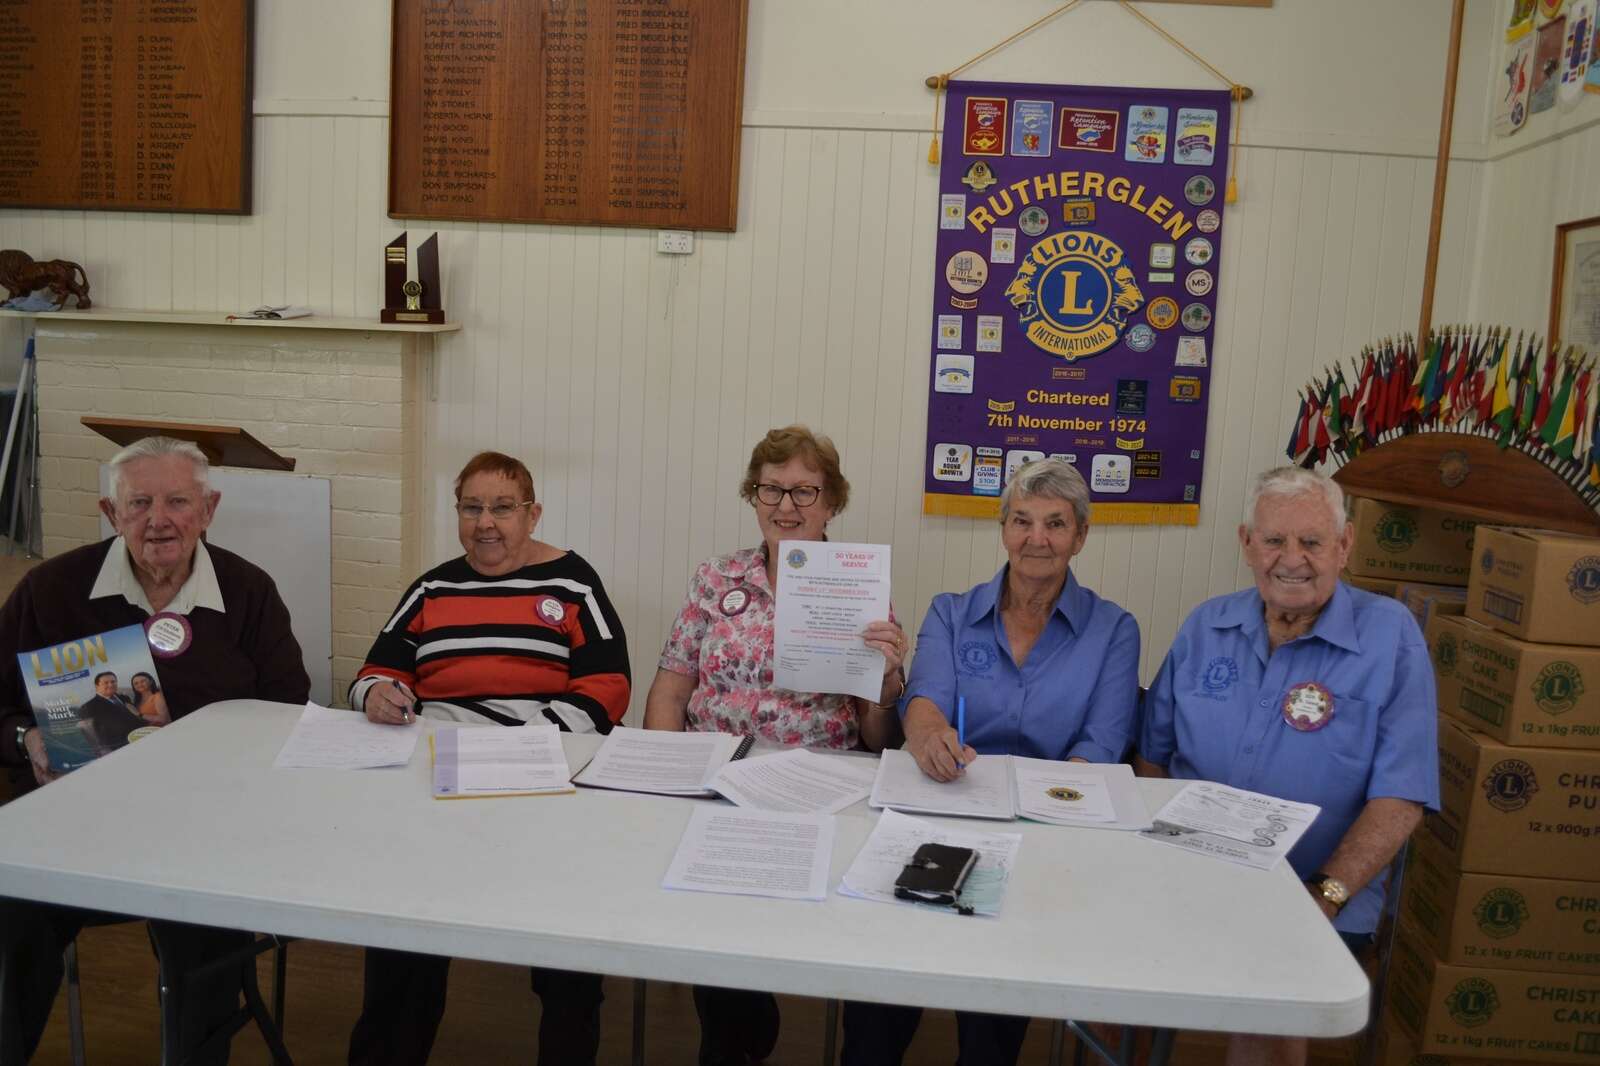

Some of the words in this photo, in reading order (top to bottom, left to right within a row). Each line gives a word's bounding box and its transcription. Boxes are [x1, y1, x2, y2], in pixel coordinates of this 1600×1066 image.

[967, 171, 1193, 241] RUTHERGLEN
[1037, 234, 1118, 263] LIONS
[1191, 279, 1207, 287] MS
[1058, 271, 1093, 315] L
[1032, 325, 1112, 352] INTERNATIONAL
[1026, 389, 1110, 406] Chartered
[987, 413, 1013, 428] 7th
[1018, 414, 1103, 432] November
[1108, 418, 1147, 433] 1974
[1409, 562, 1441, 573] FRUIT
[31, 634, 109, 680] LION
[1548, 724, 1568, 736] 1kg
[1529, 821, 1541, 832] 12
[1557, 823, 1591, 838] 900g
[1516, 949, 1553, 961] FRUIT
[1487, 1037, 1523, 1049] FRUIT
[1527, 1039, 1571, 1051] CAKES
